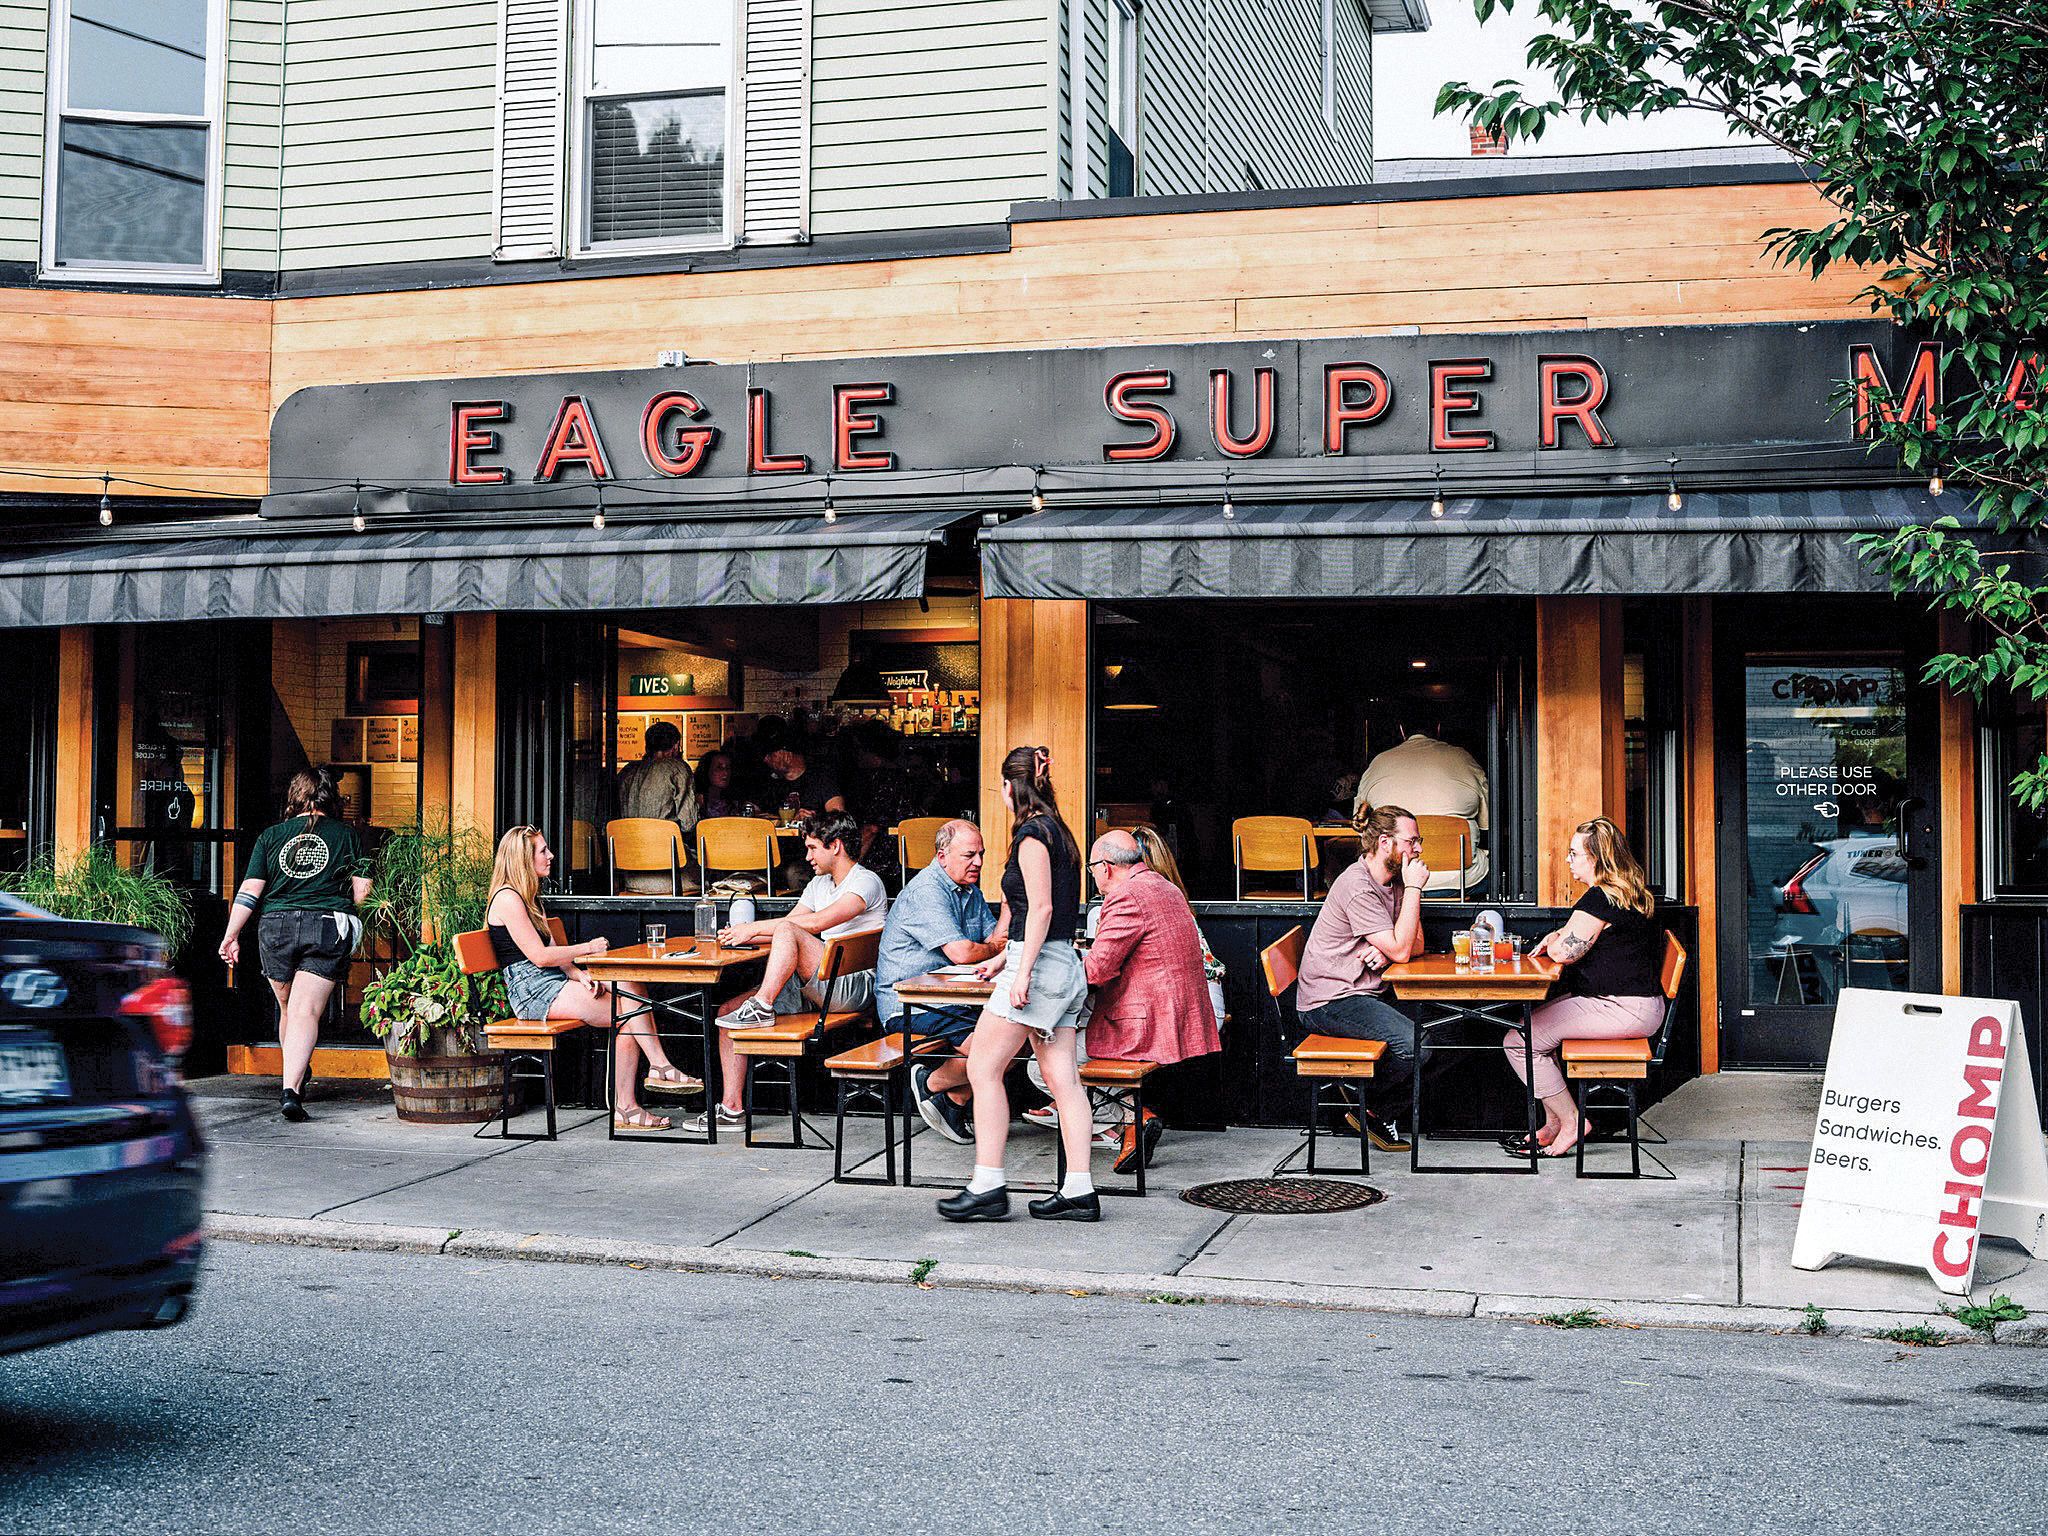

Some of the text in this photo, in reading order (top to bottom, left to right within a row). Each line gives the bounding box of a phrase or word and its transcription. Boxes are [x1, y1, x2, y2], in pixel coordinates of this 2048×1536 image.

[448, 382, 897, 486] EAGLE
[1103, 353, 1616, 463] SUPER
[639, 677, 685, 694] IVES ST
[886, 674, 921, 689] Neighbor!
[1772, 678, 1878, 700] CHOMP
[1851, 728, 1877, 736] CLOSE
[1854, 738, 1880, 746] CLOSE
[1780, 766, 1872, 779] PLEASE USE
[1775, 783, 1877, 796] OTHER DOOR
[1847, 849, 1883, 859] TUNER
[1824, 1090, 1901, 1114] Burgers
[1818, 1119, 1942, 1150] Sandwiches.
[1932, 1015, 2007, 1277] CHOMP
[1813, 1148, 1872, 1172] Beers.
